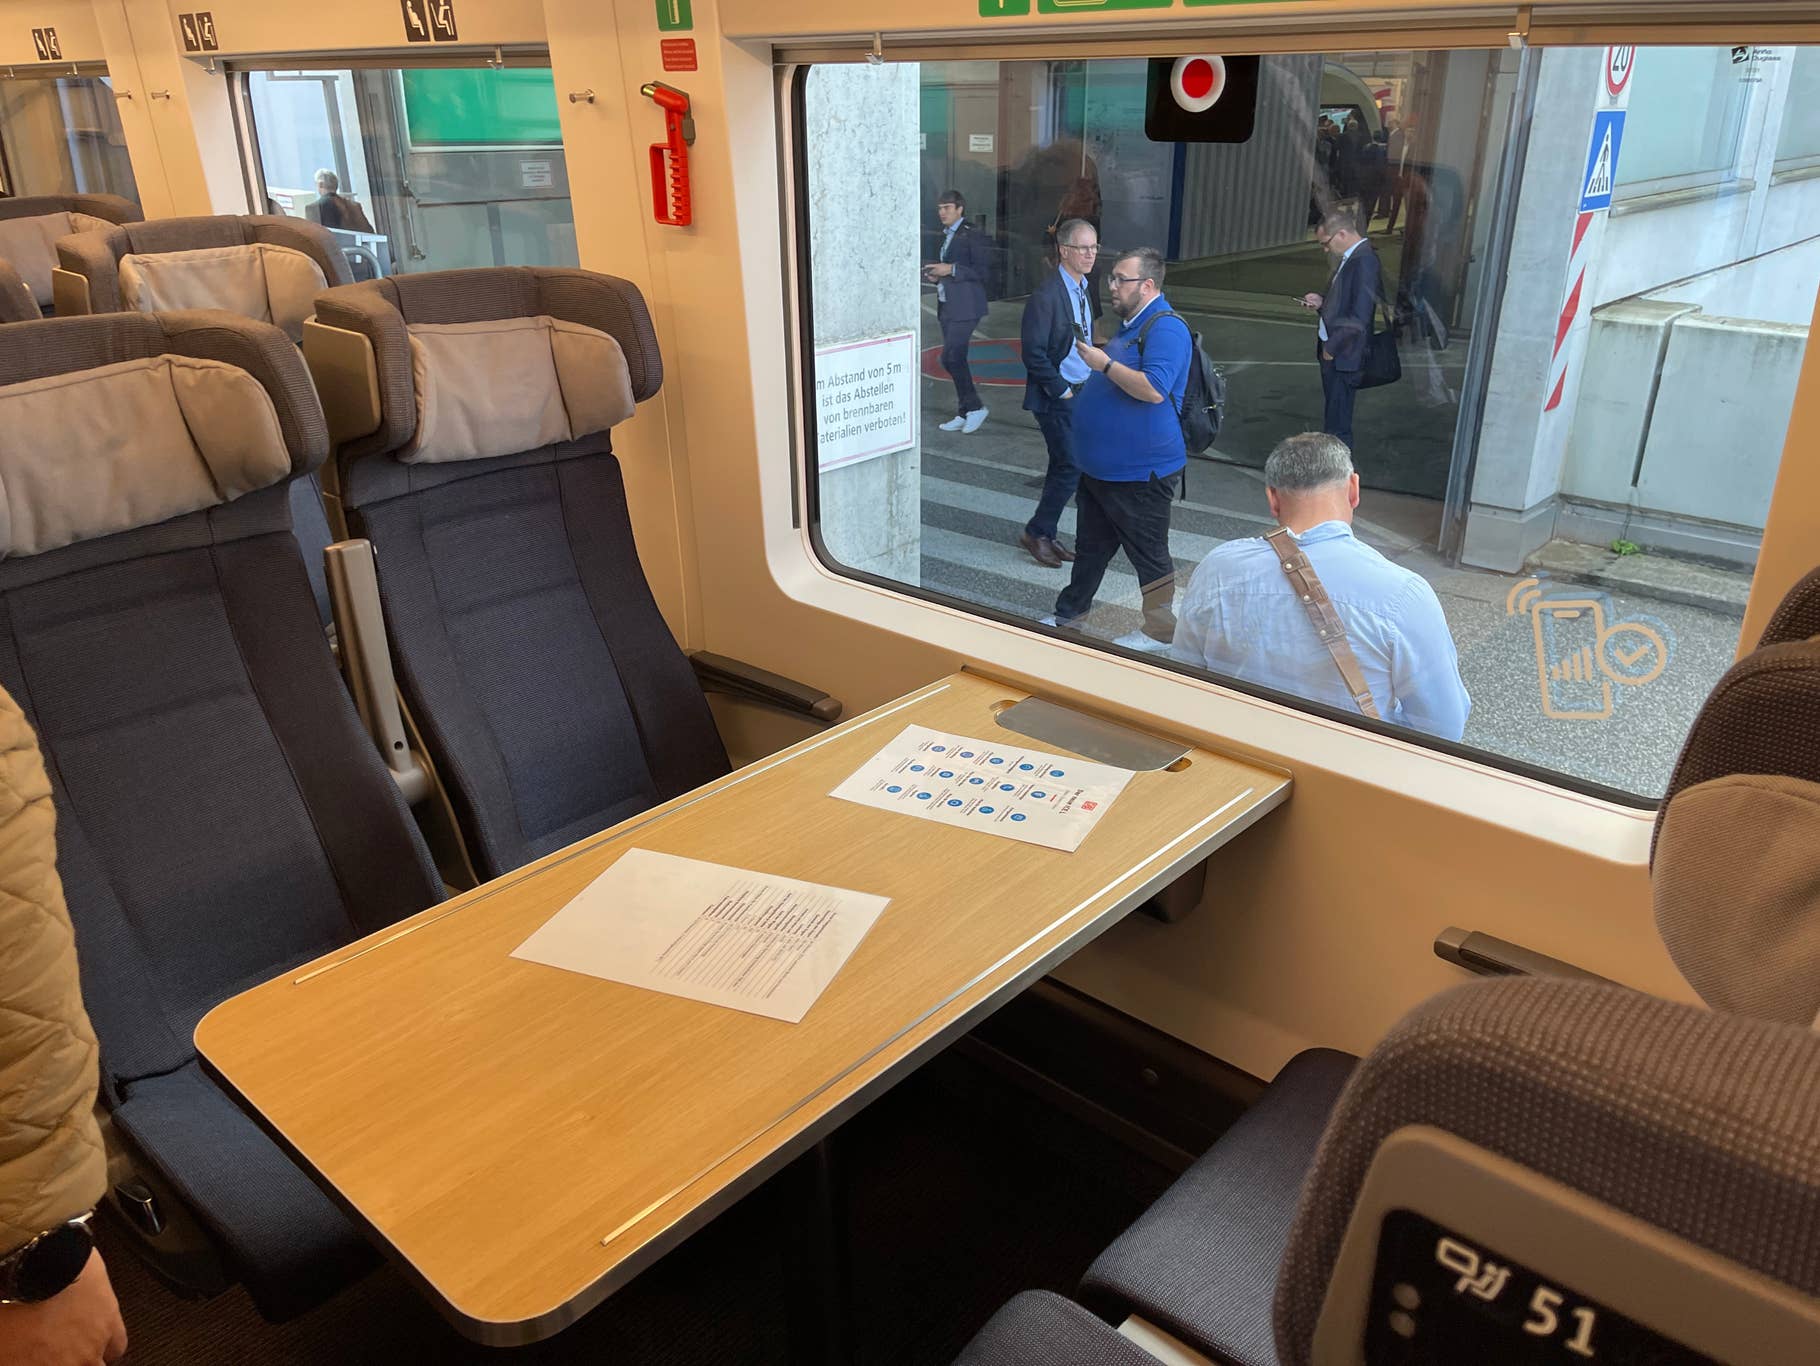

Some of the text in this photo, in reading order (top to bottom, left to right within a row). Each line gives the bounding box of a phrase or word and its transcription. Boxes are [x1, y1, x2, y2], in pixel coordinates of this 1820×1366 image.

[827, 368, 865, 388] Abstand
[868, 368, 884, 379] von
[822, 382, 894, 407] ist das Abstellen
[823, 400, 894, 425] von brennbaren
[819, 411, 906, 444] aterialien verboten!
[1522, 1286, 1596, 1358] 51
